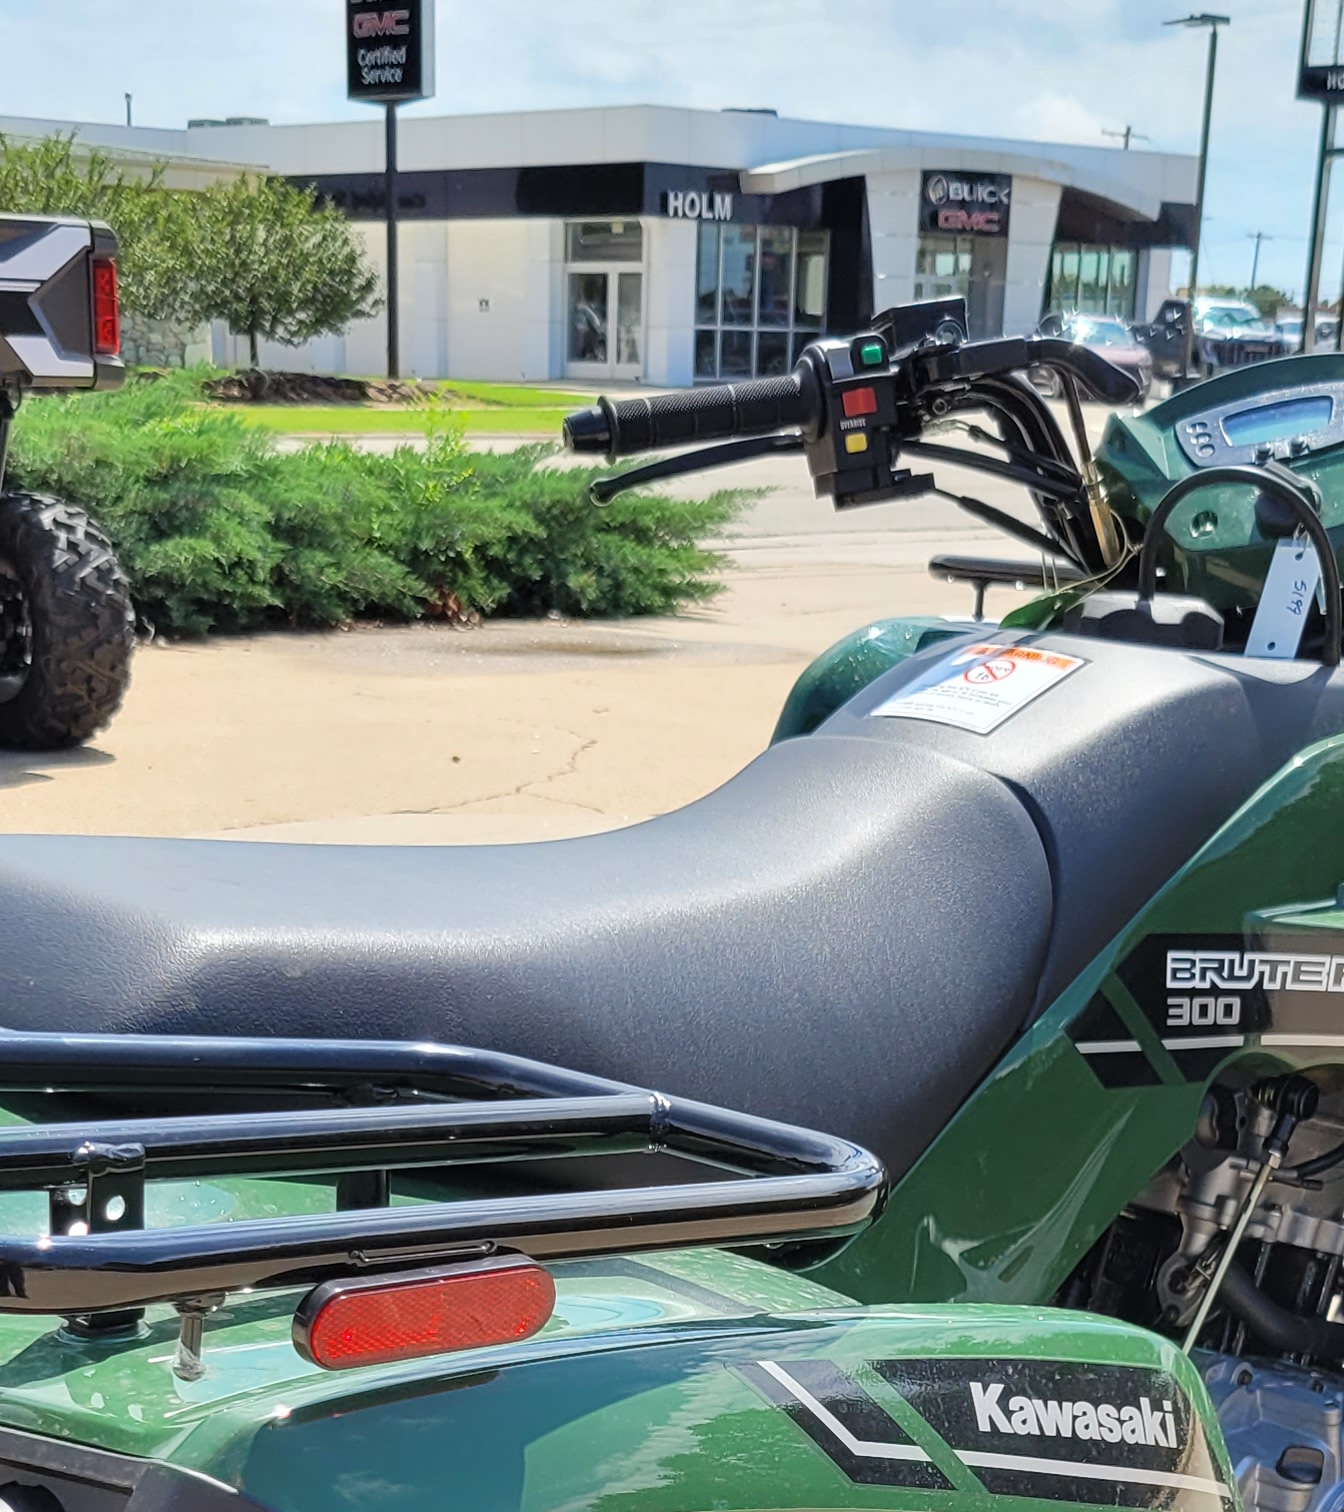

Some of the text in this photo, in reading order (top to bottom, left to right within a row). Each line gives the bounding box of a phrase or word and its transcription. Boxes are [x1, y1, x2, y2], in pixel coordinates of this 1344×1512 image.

[353, 9, 410, 38] GMC
[357, 45, 408, 67] Certified
[361, 66, 404, 85] Service
[667, 189, 734, 221] HOLM
[949, 182, 1010, 205] BUICK
[938, 209, 1000, 233] GMC
[1166, 996, 1241, 1026] 300
[969, 1381, 1179, 1450] Kawasaki
